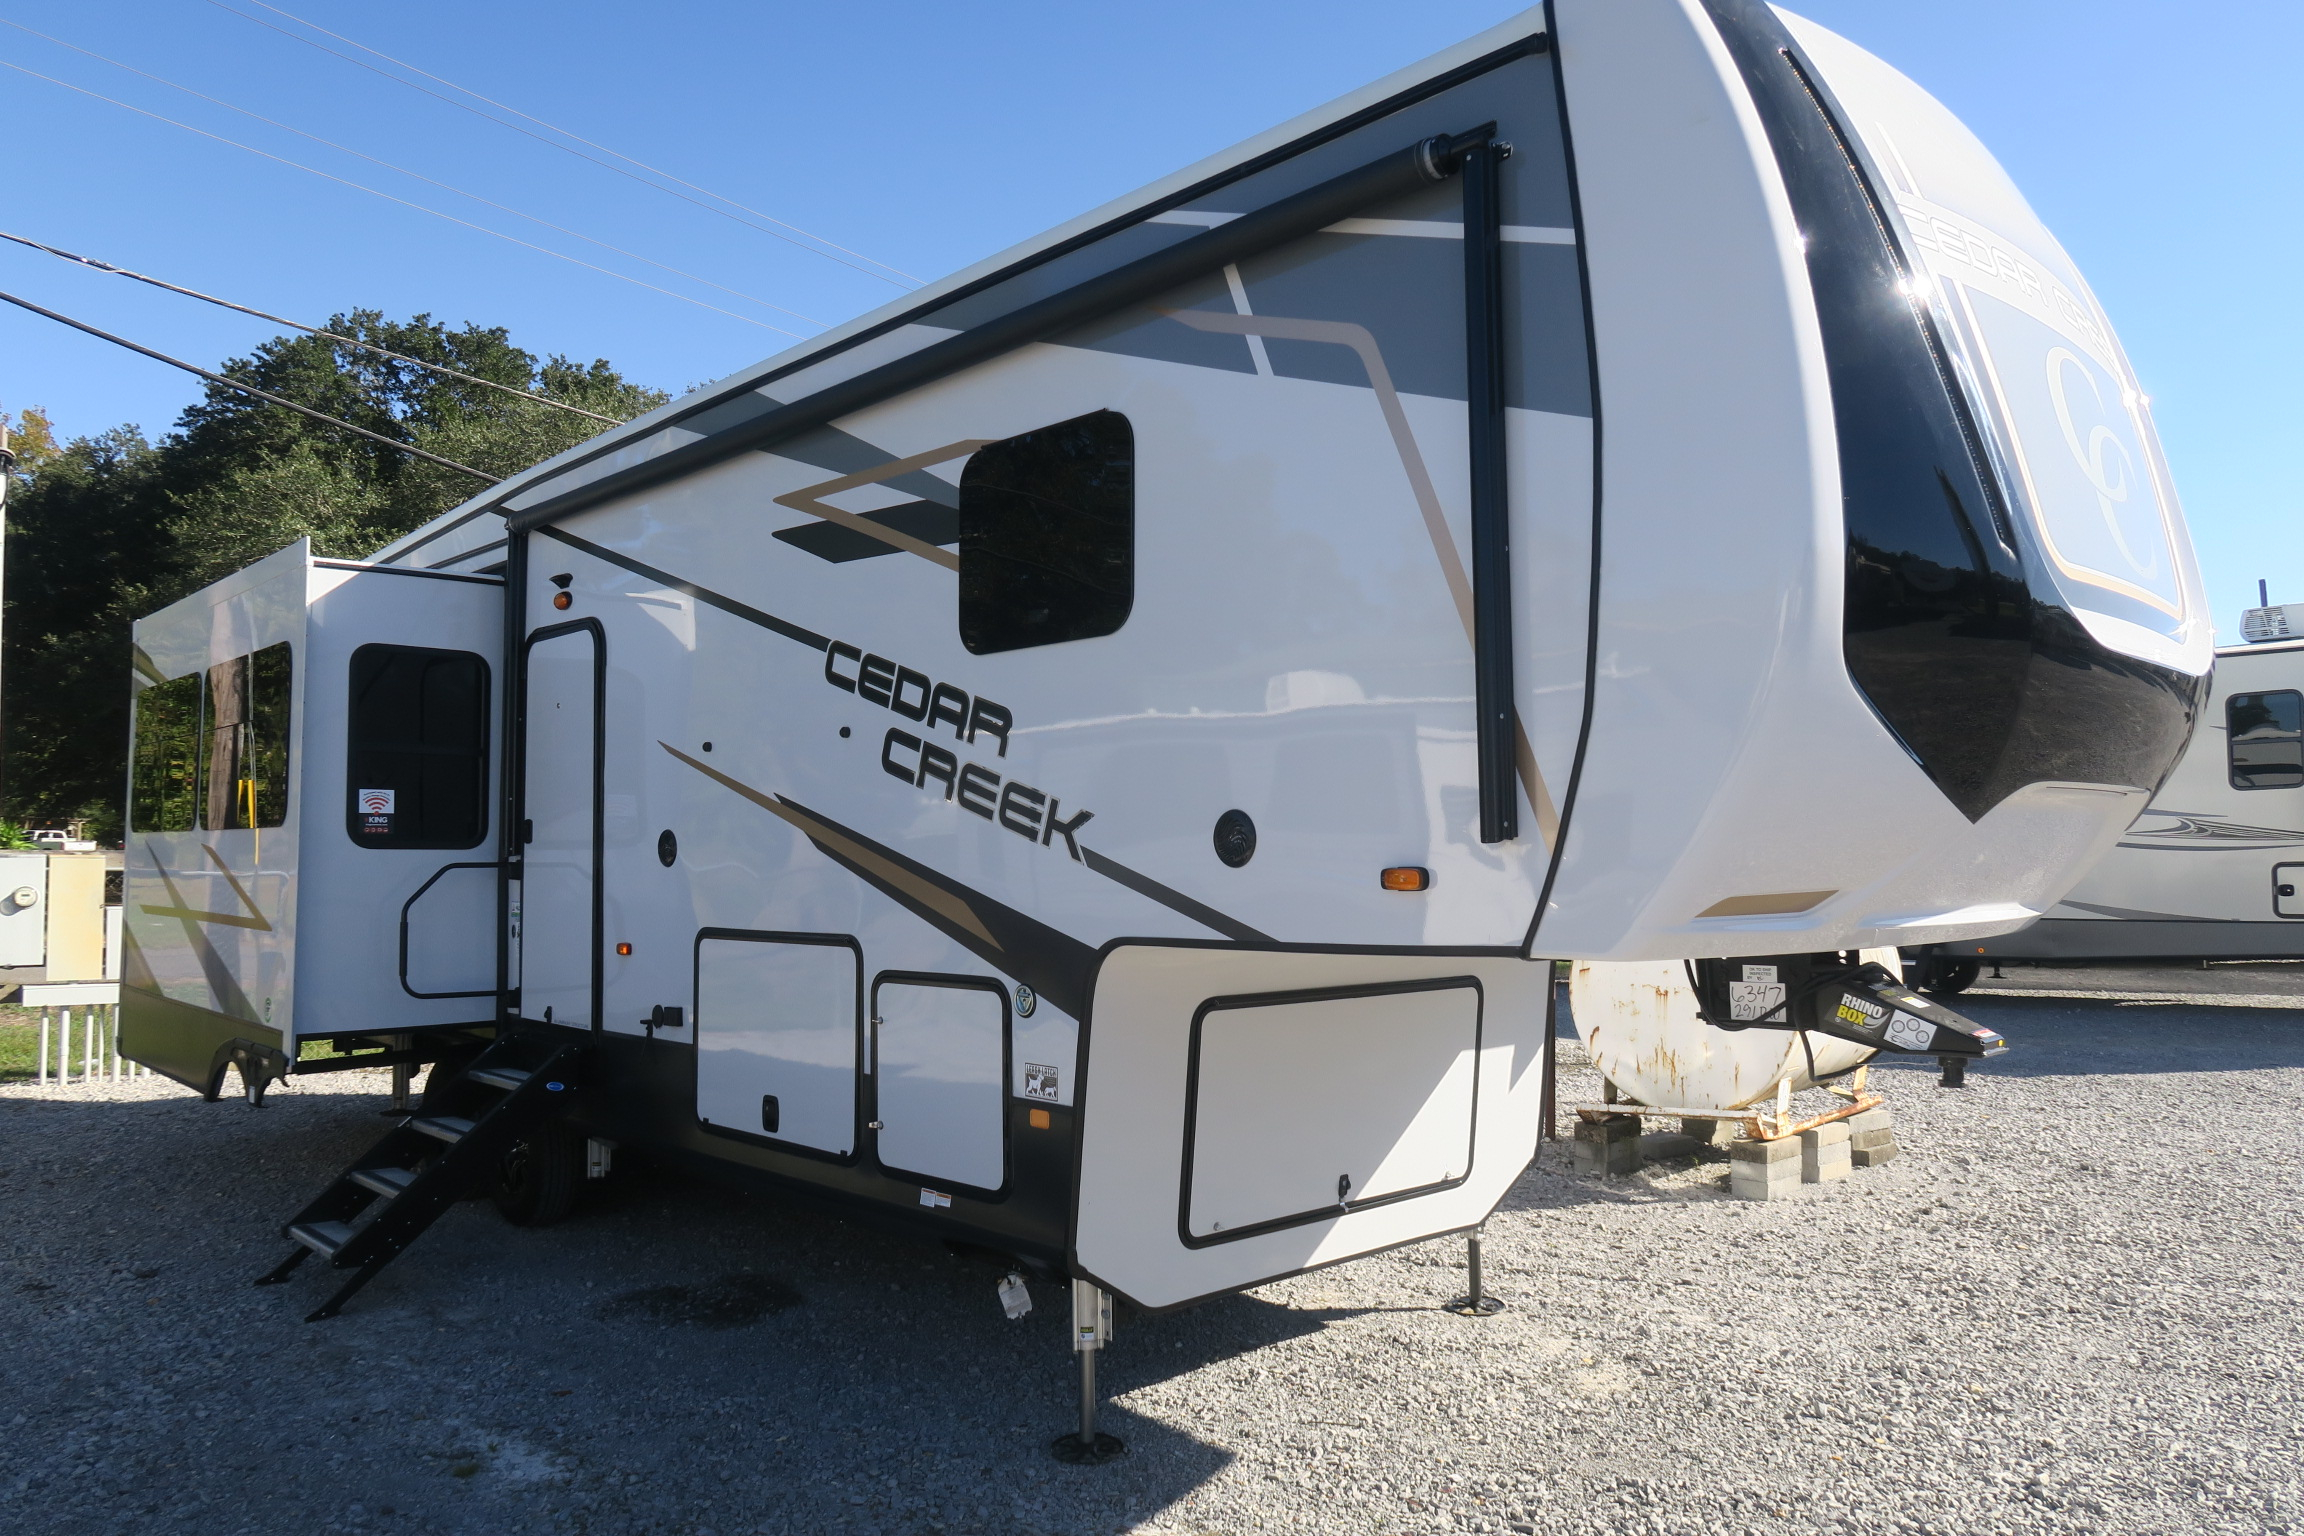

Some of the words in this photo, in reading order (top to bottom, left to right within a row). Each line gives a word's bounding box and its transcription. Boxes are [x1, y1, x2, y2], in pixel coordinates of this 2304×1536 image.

[825, 640, 1012, 759] CEDAR
[881, 727, 1095, 865] CREEK
[1732, 985, 1781, 1006] 6347
[1841, 993, 1882, 1018] RHINO
[1837, 1005, 1867, 1026] BOX
